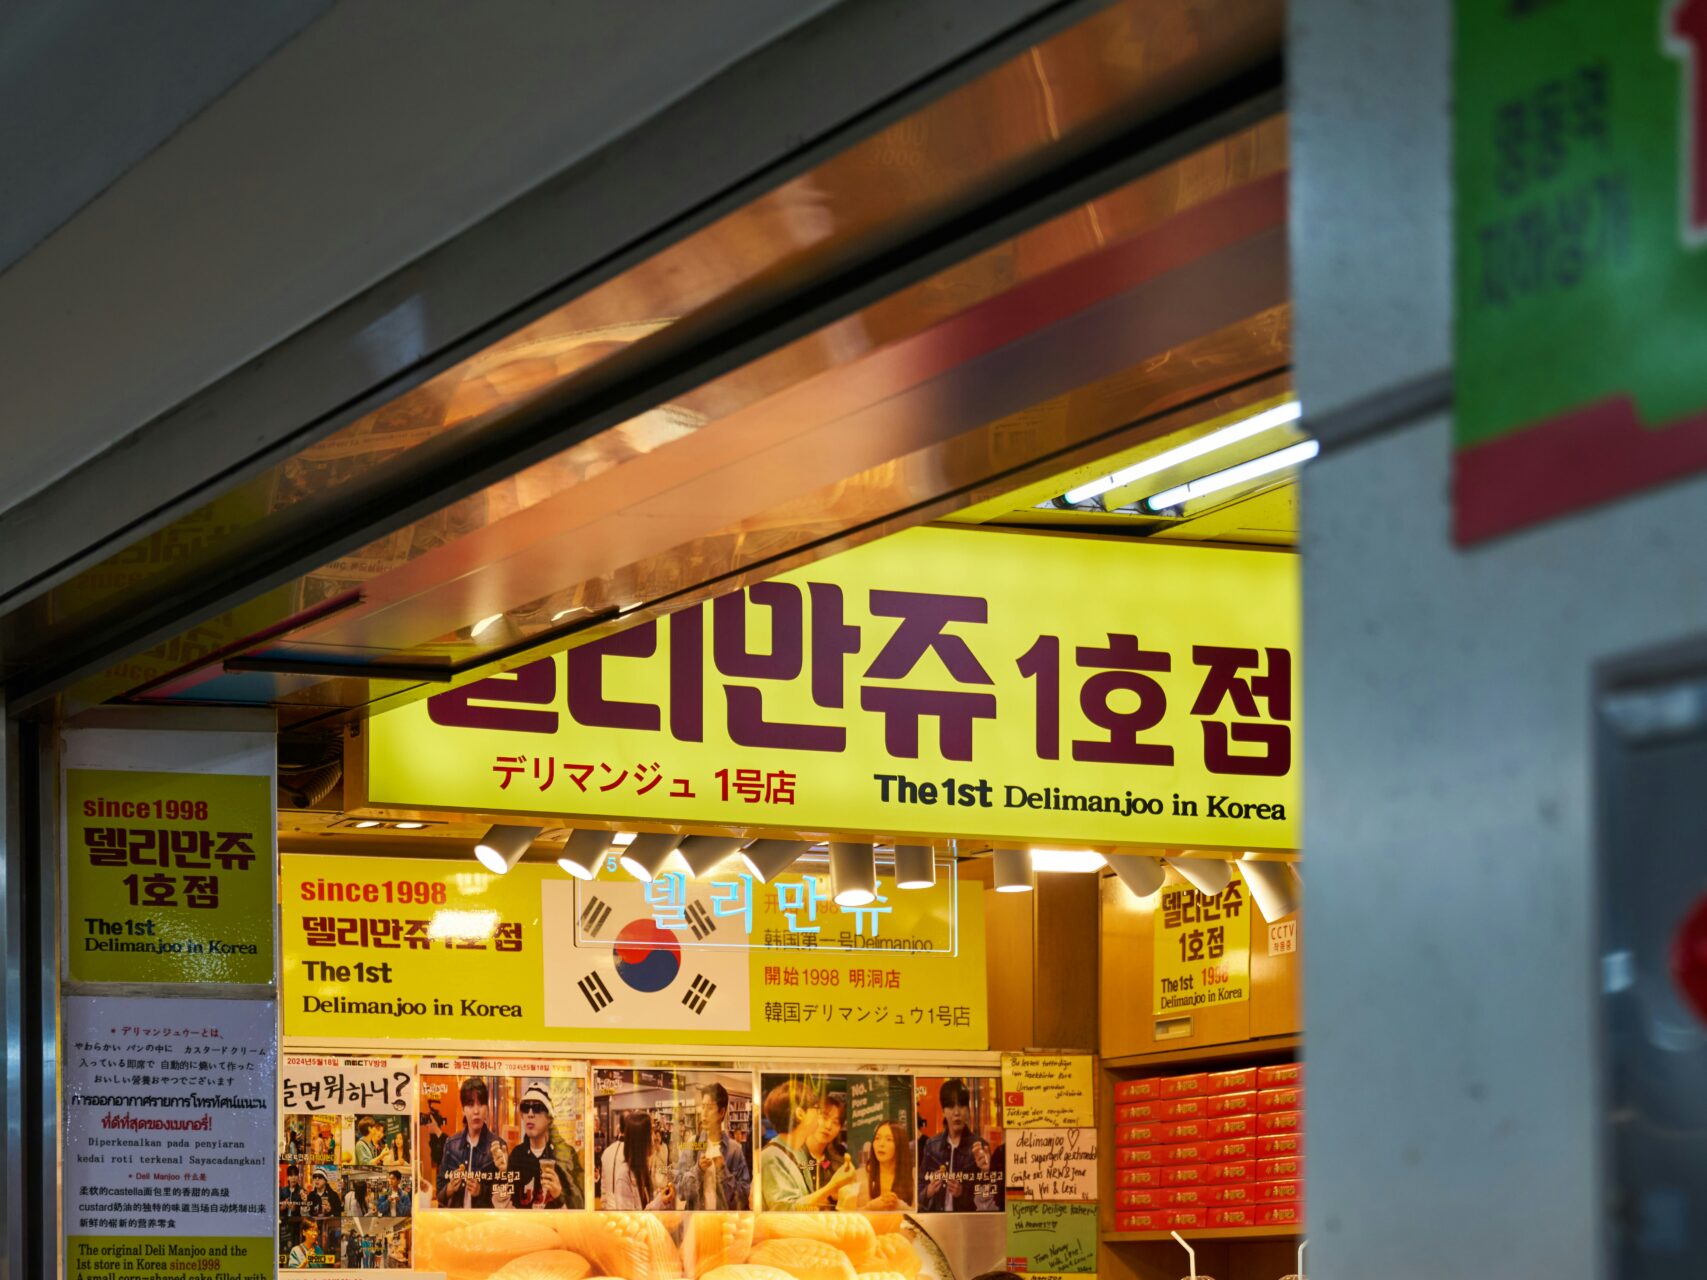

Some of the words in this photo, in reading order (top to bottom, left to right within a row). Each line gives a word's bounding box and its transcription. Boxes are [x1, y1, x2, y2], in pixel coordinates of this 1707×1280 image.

[1016, 632, 1292, 776] 1호점
[492, 755, 696, 799] デリマンジュ
[715, 768, 797, 805] 1号店
[1004, 785, 1164, 817] Delimanjoo
[1172, 794, 1198, 816] in
[1206, 796, 1287, 821] Korea
[83, 828, 256, 870] 델리만쥬
[122, 873, 219, 909] 1호점
[84, 937, 182, 955] Delimanjoo
[186, 940, 204, 955] in
[208, 940, 258, 955] Korea
[1179, 926, 1225, 963] 1호점
[1271, 924, 1295, 941] CCTV
[849, 969, 901, 989] 明洞店
[302, 995, 427, 1017] Delimanjoo
[433, 997, 454, 1016] in
[460, 999, 523, 1018] Korea
[88, 1137, 162, 1149] Diperkenalkan
[167, 1138, 190, 1150] pada
[195, 1139, 245, 1151] penyiaran
[78, 1244, 99, 1256] The
[101, 1245, 143, 1259] original
[145, 1245, 167, 1257] Deli
[168, 1245, 206, 1259] Manjoo
[208, 1246, 228, 1257] and
[230, 1246, 248, 1257] the
